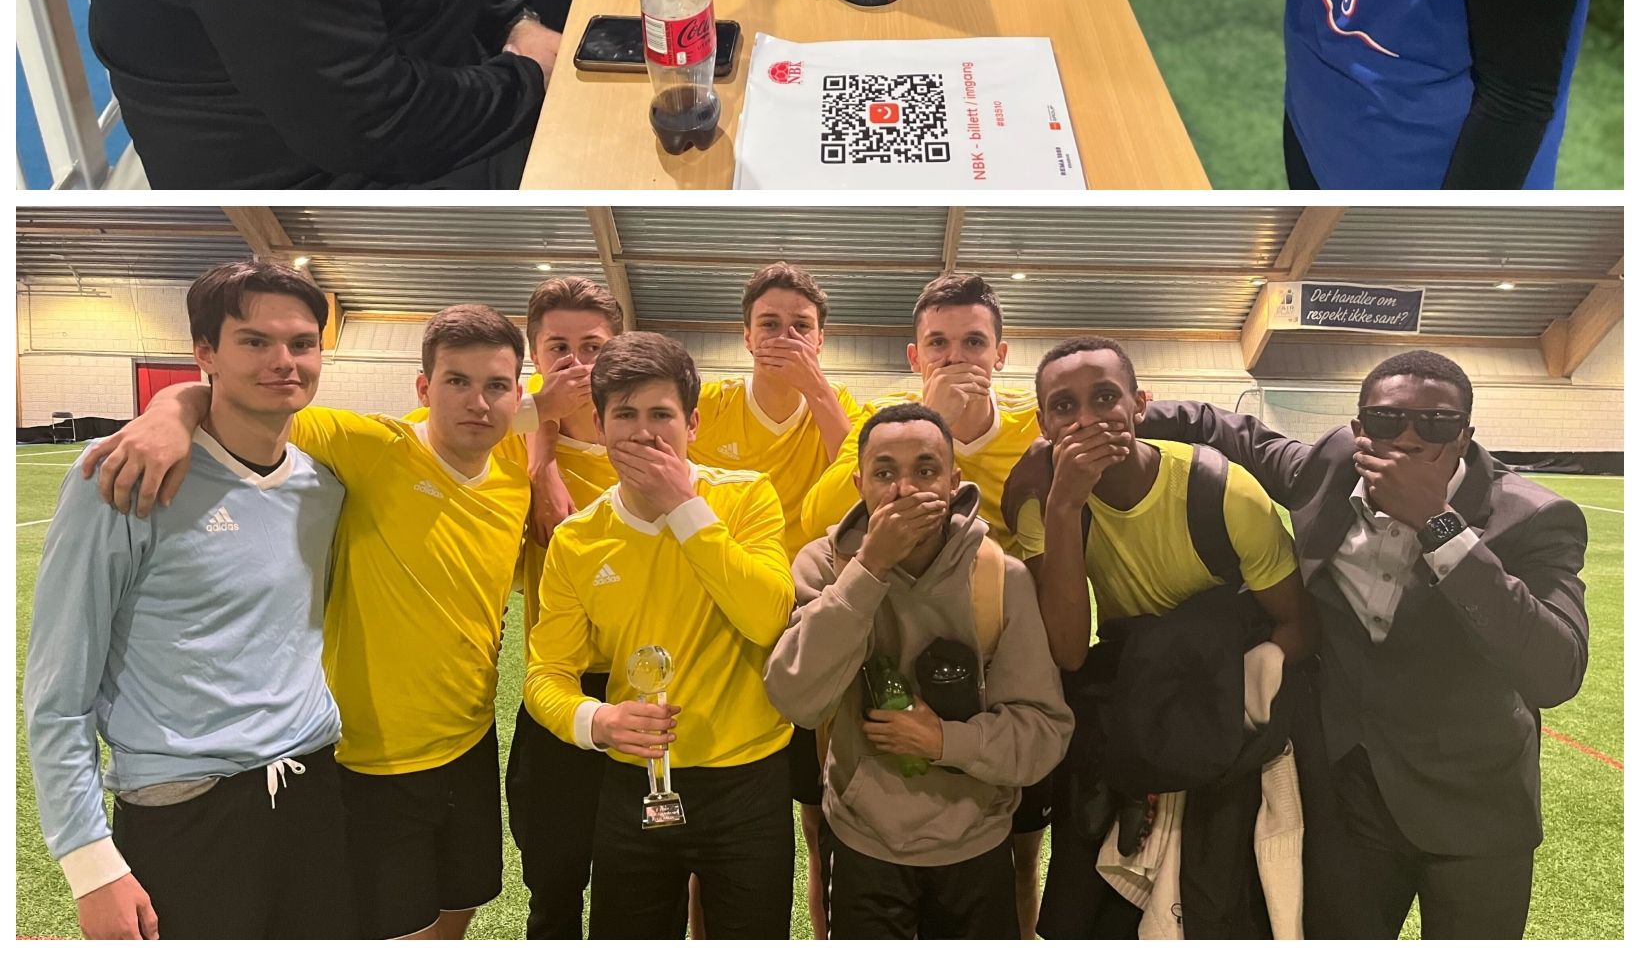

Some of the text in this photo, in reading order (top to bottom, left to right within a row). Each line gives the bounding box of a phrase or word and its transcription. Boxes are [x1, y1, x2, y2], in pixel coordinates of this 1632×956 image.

[962, 61, 976, 100] inngang
[966, 107, 981, 140] billett
[971, 152, 987, 180] NBK
[1310, 288, 1397, 307] Det handler om
[1306, 306, 1409, 325] respekt, ikke sant?
[206, 523, 240, 532] adidas
